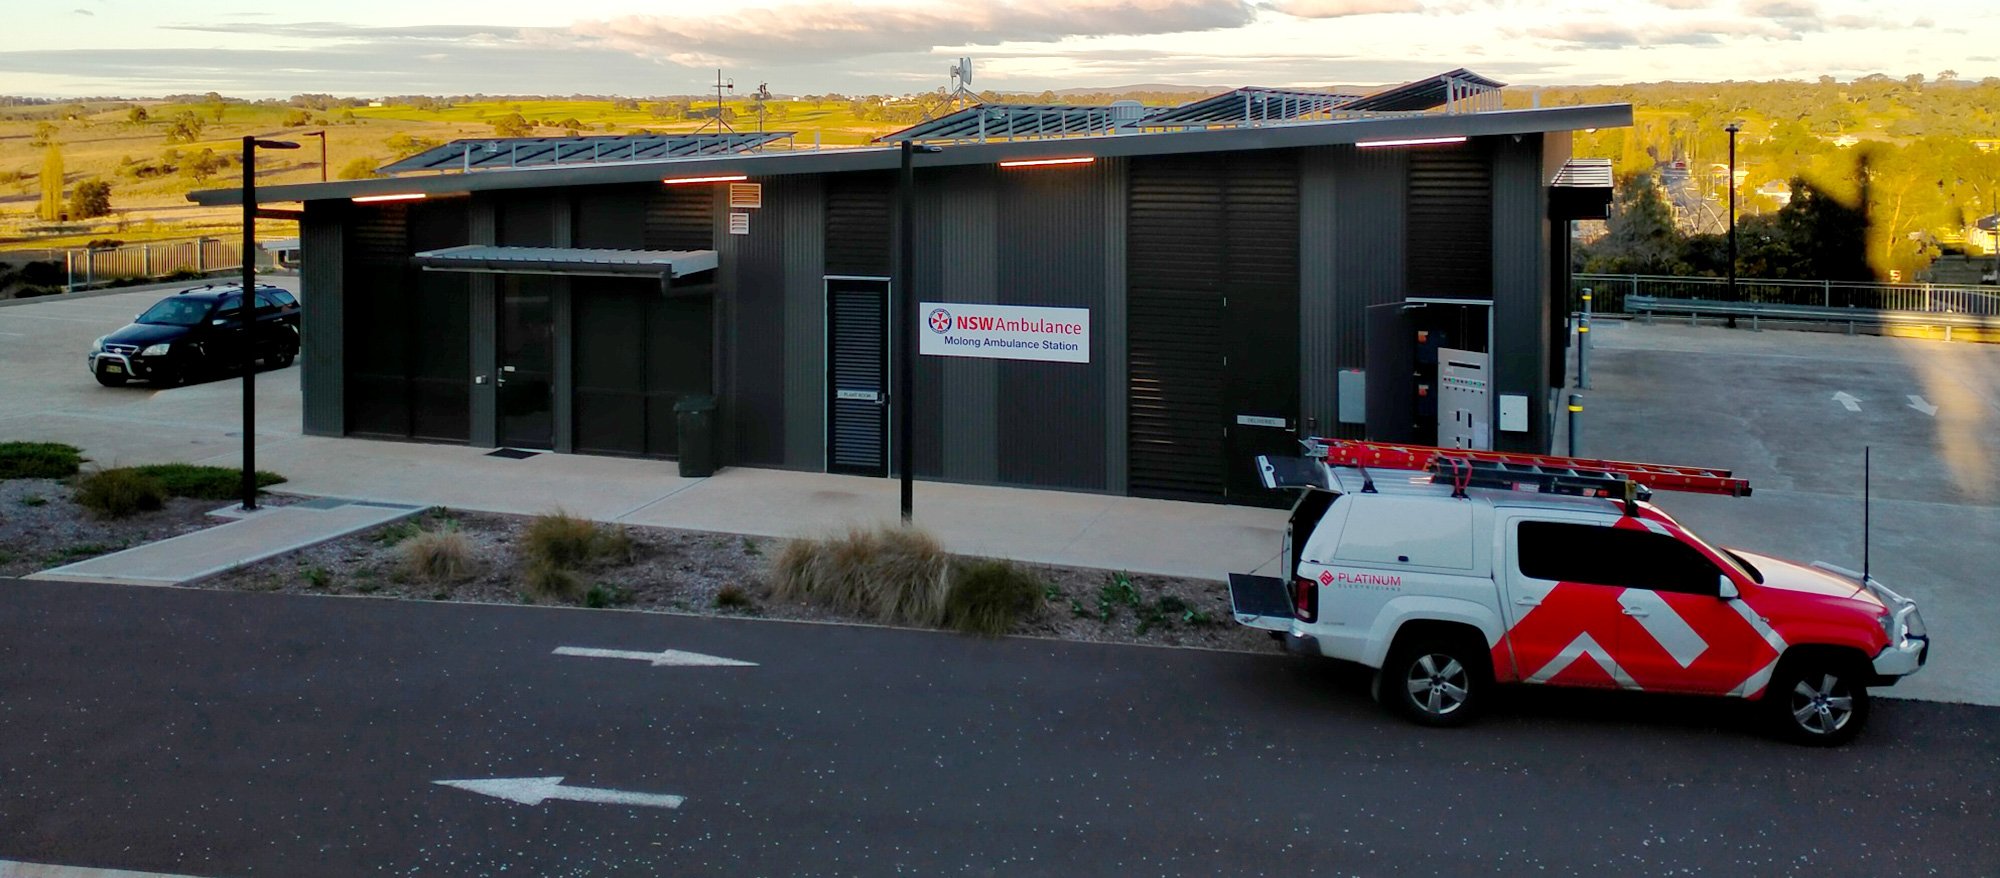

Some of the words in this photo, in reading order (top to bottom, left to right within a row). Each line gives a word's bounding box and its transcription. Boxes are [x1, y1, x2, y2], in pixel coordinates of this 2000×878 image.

[957, 315, 994, 331] NSW
[995, 317, 1082, 335] Ambulance
[944, 335, 981, 348] Molong
[983, 337, 1040, 349] Ambulance
[1042, 340, 1078, 351] Station
[1338, 572, 1401, 586] PLATINUM
